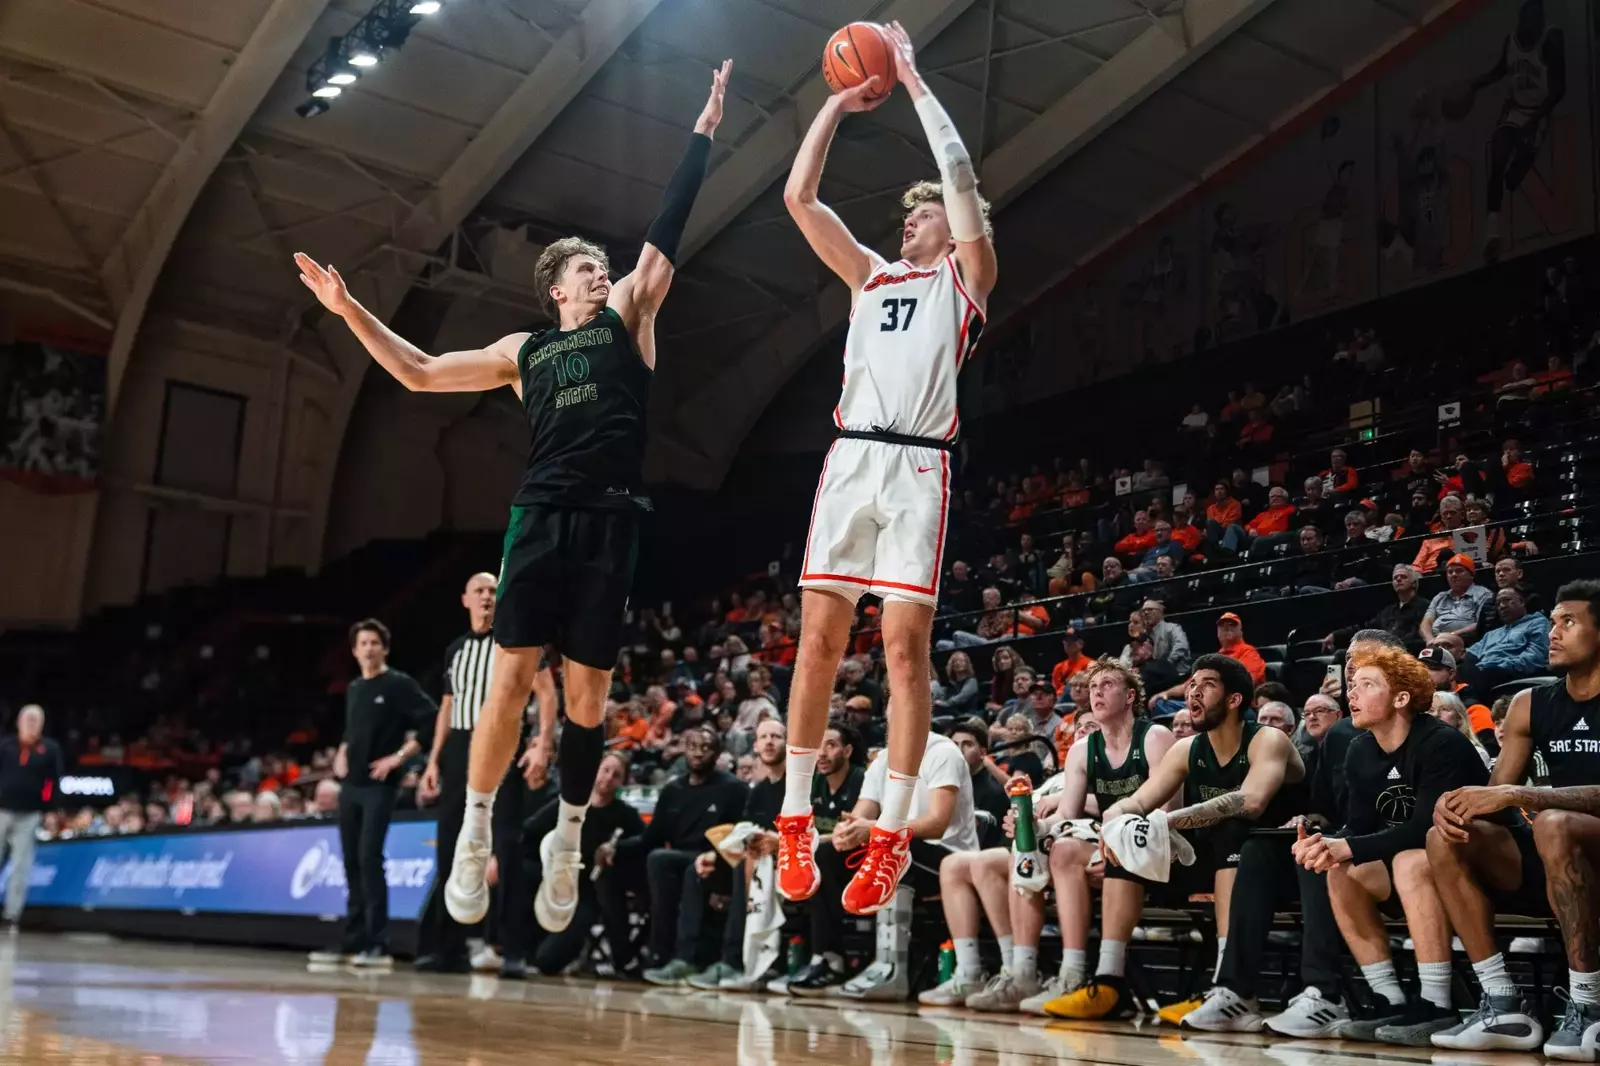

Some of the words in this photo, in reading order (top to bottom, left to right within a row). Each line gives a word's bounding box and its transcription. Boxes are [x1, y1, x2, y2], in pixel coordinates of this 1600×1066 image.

[864, 270, 937, 292] Beavers
[880, 298, 918, 332] 37
[527, 328, 613, 369] SACRAMENTO
[552, 351, 590, 387] 10
[555, 383, 599, 409] STATE
[1549, 740, 1572, 753] SAC
[1574, 739, 1600, 753] STA
